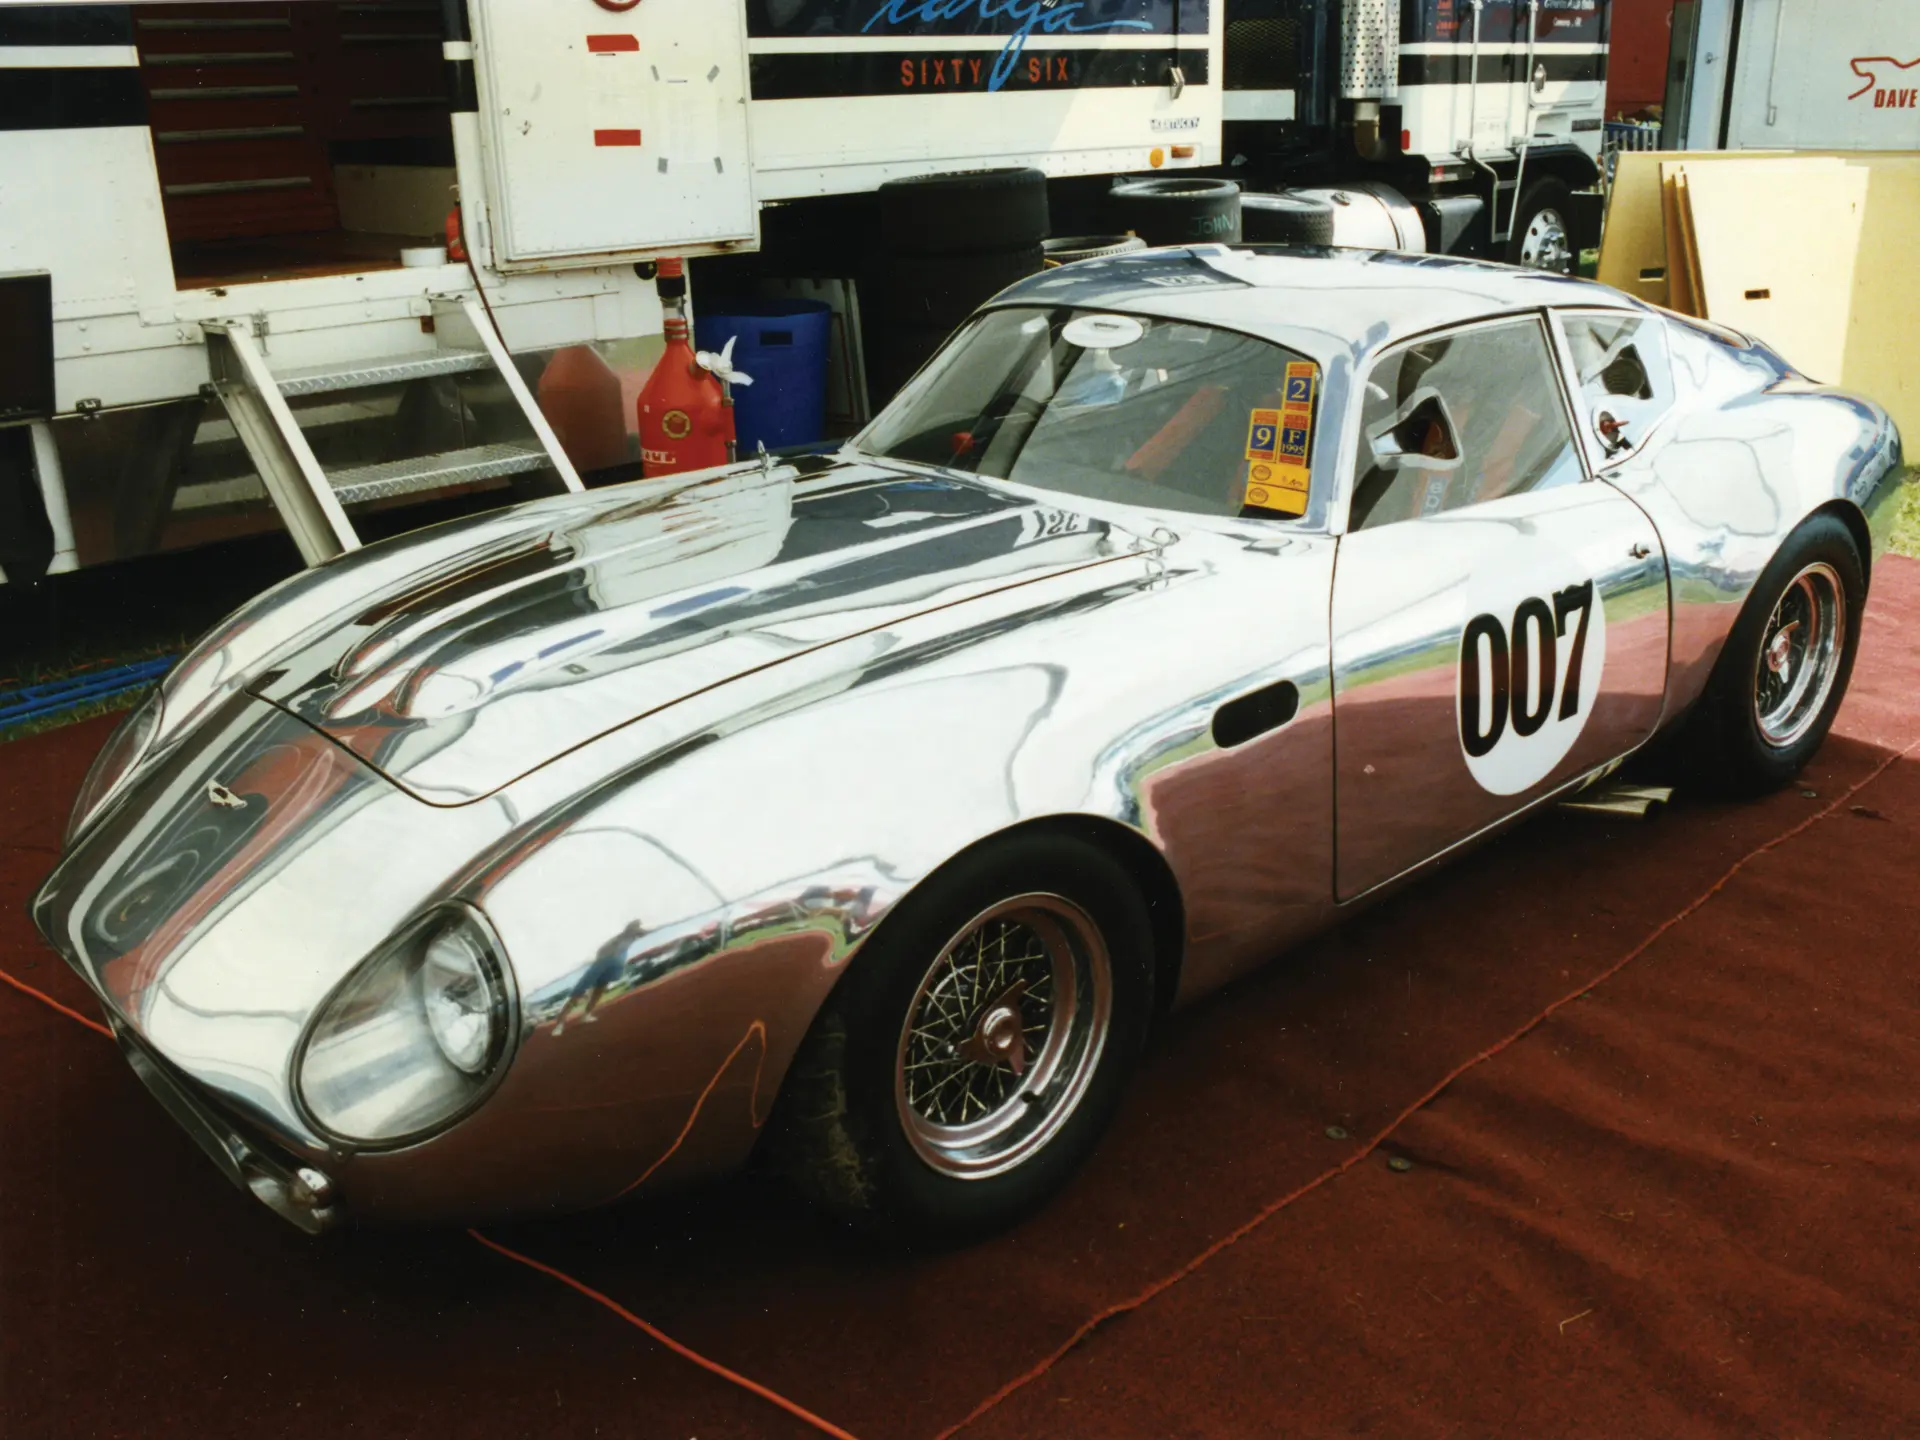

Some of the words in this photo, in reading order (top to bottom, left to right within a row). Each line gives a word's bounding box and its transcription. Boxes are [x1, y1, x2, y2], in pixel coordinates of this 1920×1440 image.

[901, 58, 981, 86] SIXTY
[1028, 57, 1068, 82] SIX
[1873, 88, 1918, 108] DAVE
[1291, 379, 1307, 399] 2
[1255, 427, 1272, 447] 9
[1288, 429, 1302, 444] F
[1281, 443, 1305, 455] 1995
[1460, 578, 1594, 758] 007
